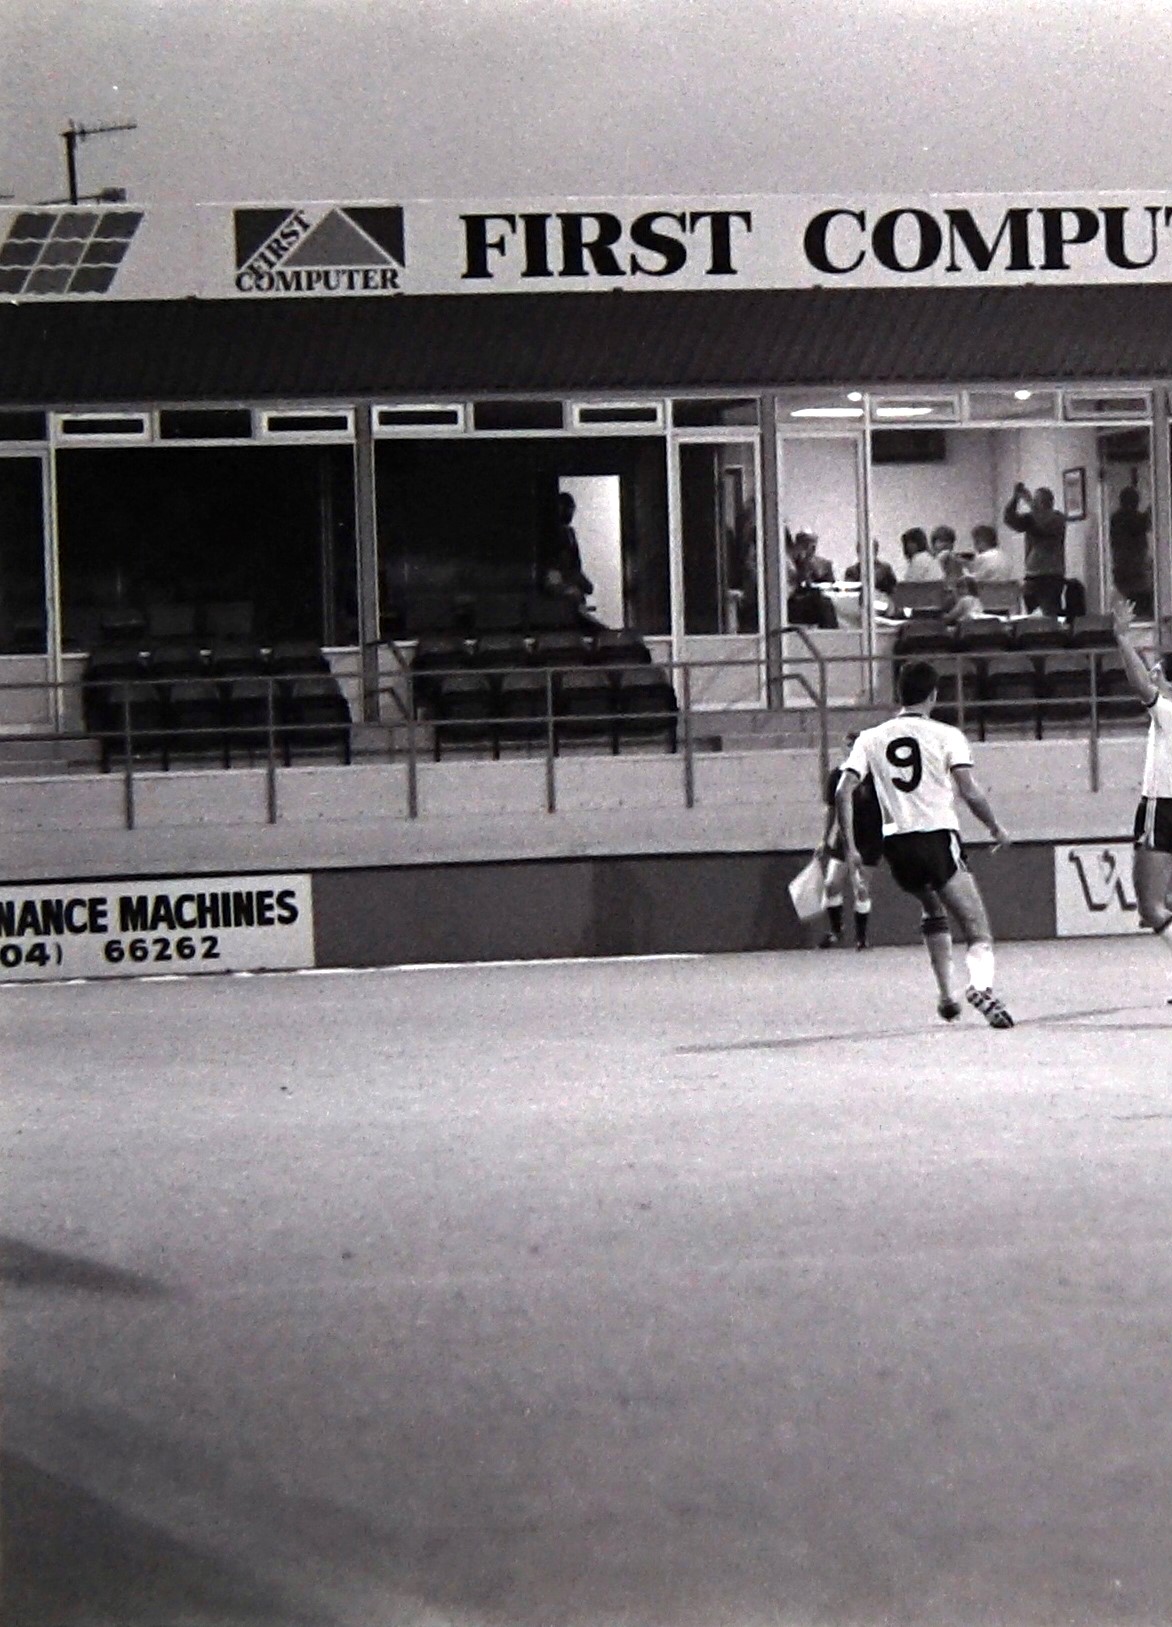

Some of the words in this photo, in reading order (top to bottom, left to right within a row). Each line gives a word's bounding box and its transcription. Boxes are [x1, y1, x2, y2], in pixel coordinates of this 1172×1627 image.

[247, 209, 310, 281] FIRST
[459, 211, 752, 280] FIRST
[235, 268, 400, 291] COMPUTER
[885, 736, 923, 793] 9
[119, 890, 299, 932] MACHINES
[104, 936, 220, 963] 66262
